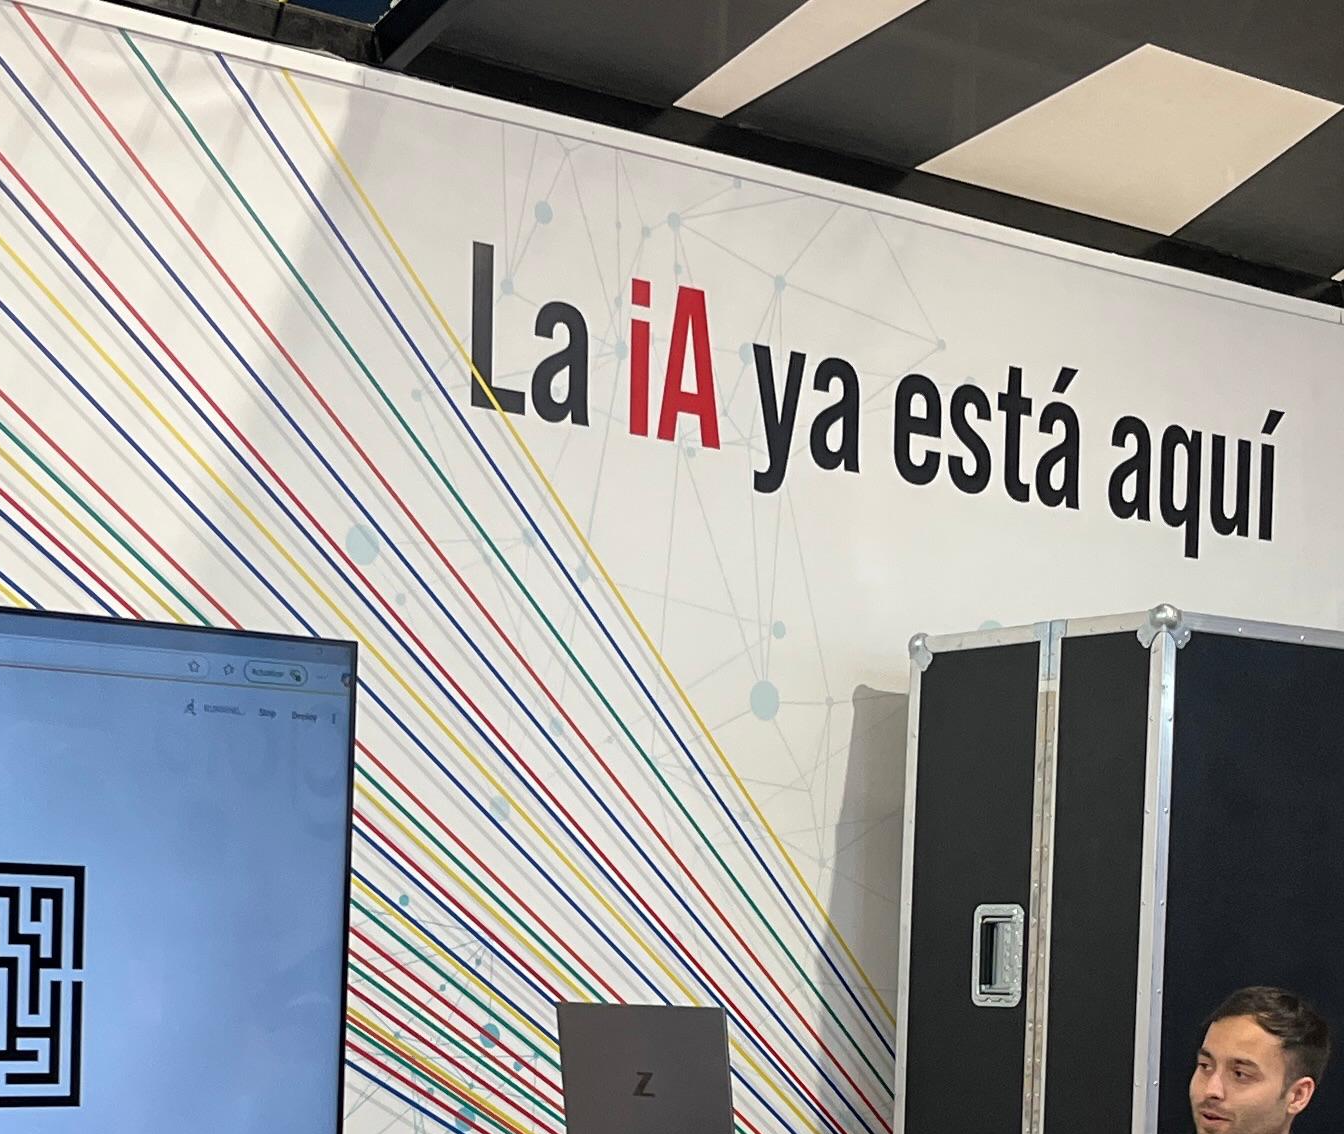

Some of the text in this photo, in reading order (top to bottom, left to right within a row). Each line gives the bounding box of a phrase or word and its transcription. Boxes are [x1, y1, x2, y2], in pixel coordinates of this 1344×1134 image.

[471, 241, 1286, 559] La iA ya está aquí
[632, 1072, 656, 1098] Z
